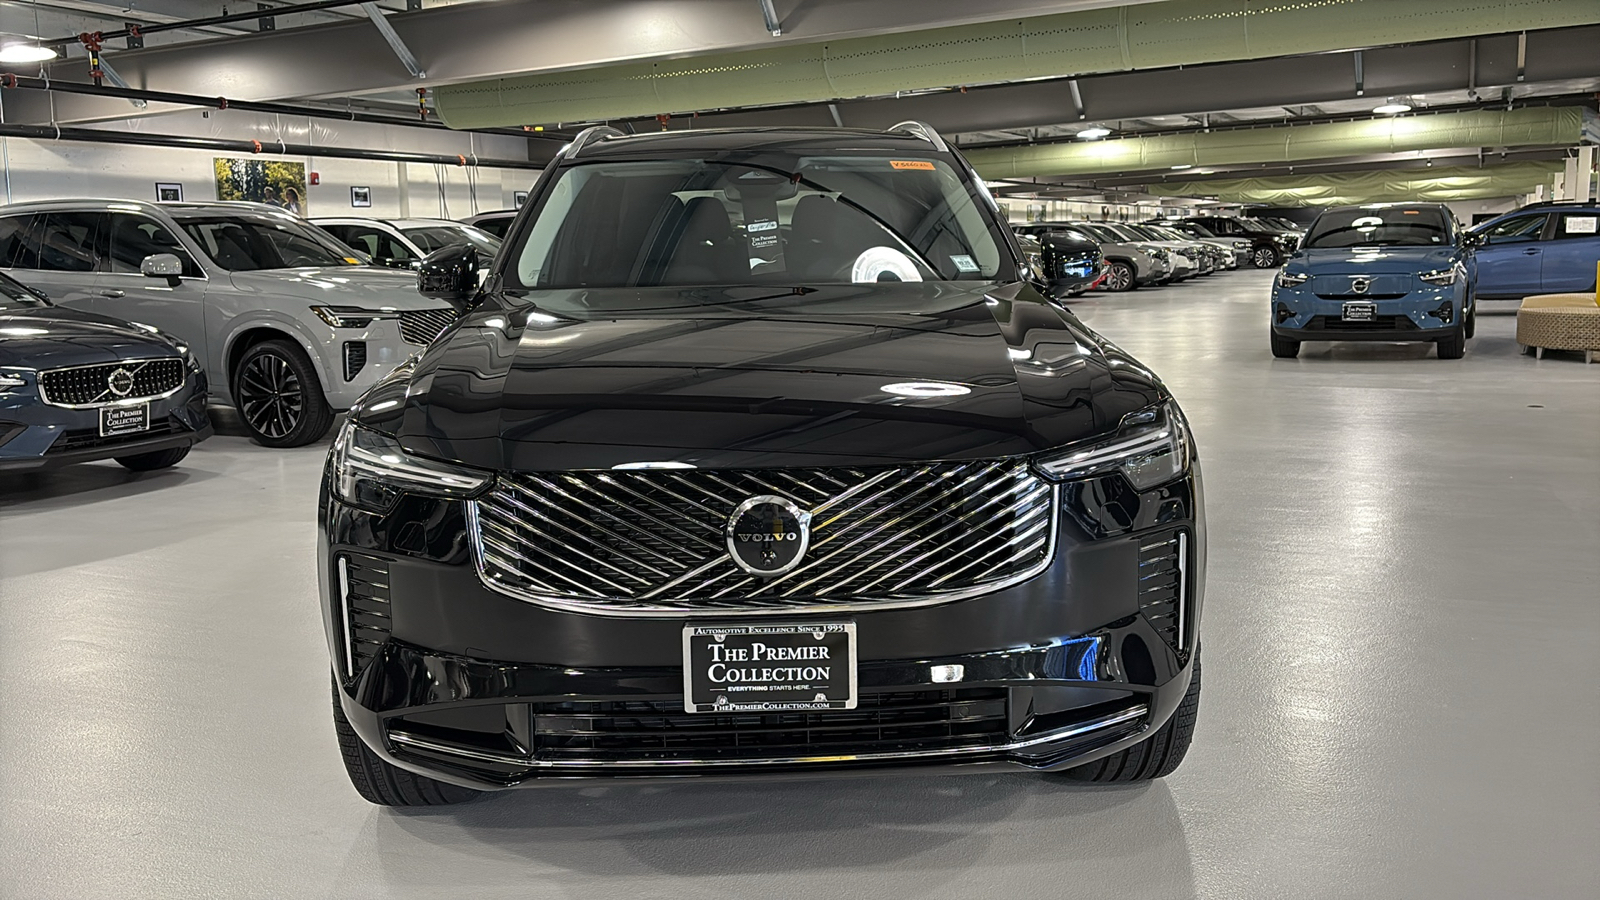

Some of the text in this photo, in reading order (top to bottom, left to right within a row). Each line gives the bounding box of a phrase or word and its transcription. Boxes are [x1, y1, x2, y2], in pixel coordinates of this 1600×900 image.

[738, 532, 798, 542] VOLVO
[822, 624, 844, 632] 1995
[707, 663, 831, 683] COLLECTION
[727, 684, 769, 692] EVERYTHING
[769, 684, 792, 692] STARTS
